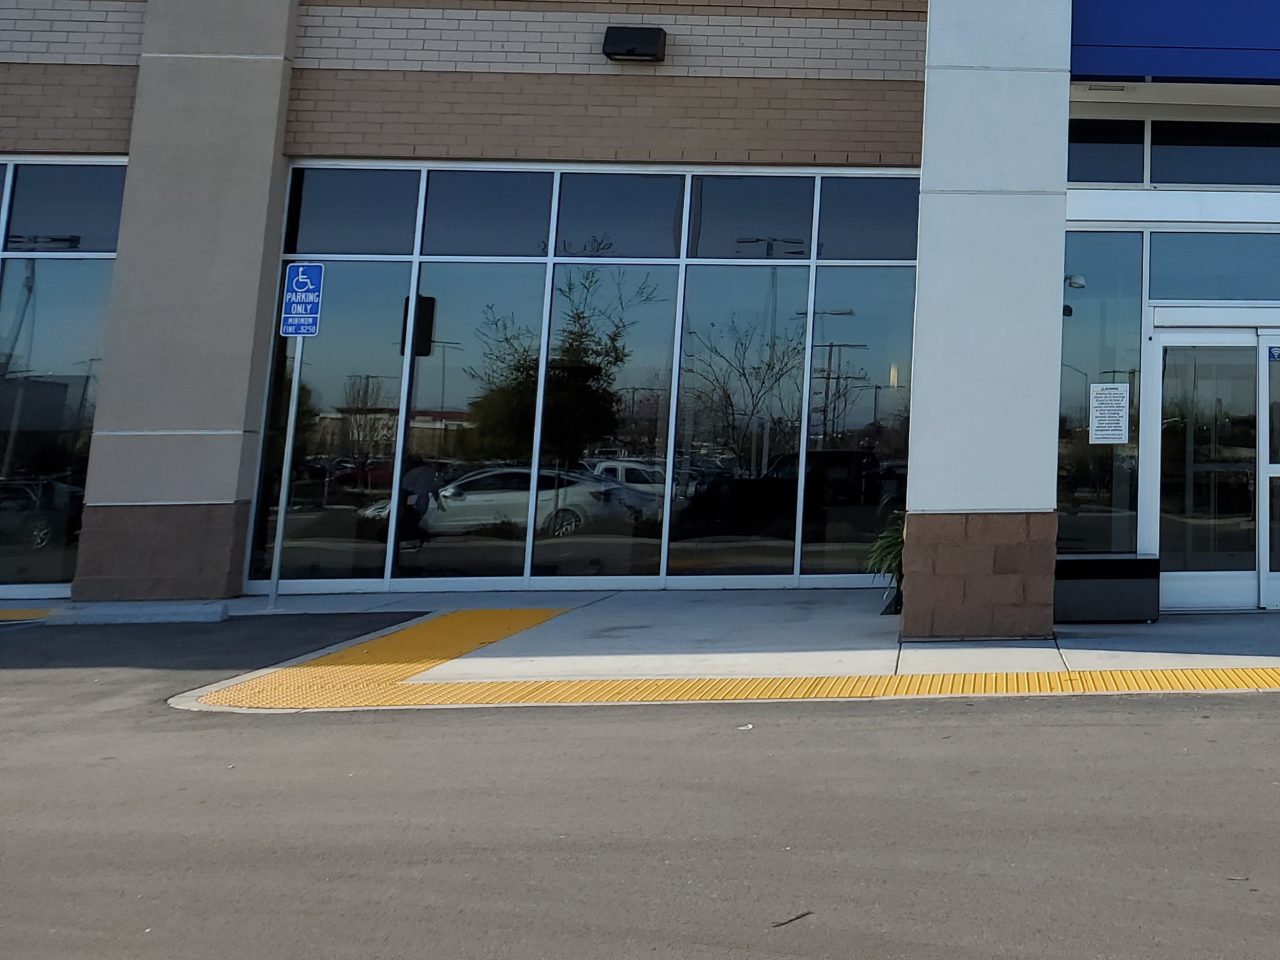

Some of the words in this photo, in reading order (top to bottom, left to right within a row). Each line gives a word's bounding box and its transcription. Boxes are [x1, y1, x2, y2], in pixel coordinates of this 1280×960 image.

[286, 292, 319, 303] PARKING
[291, 303, 312, 314] ONLY
[287, 317, 313, 325] MINIMUM
[283, 325, 296, 333] FINE
